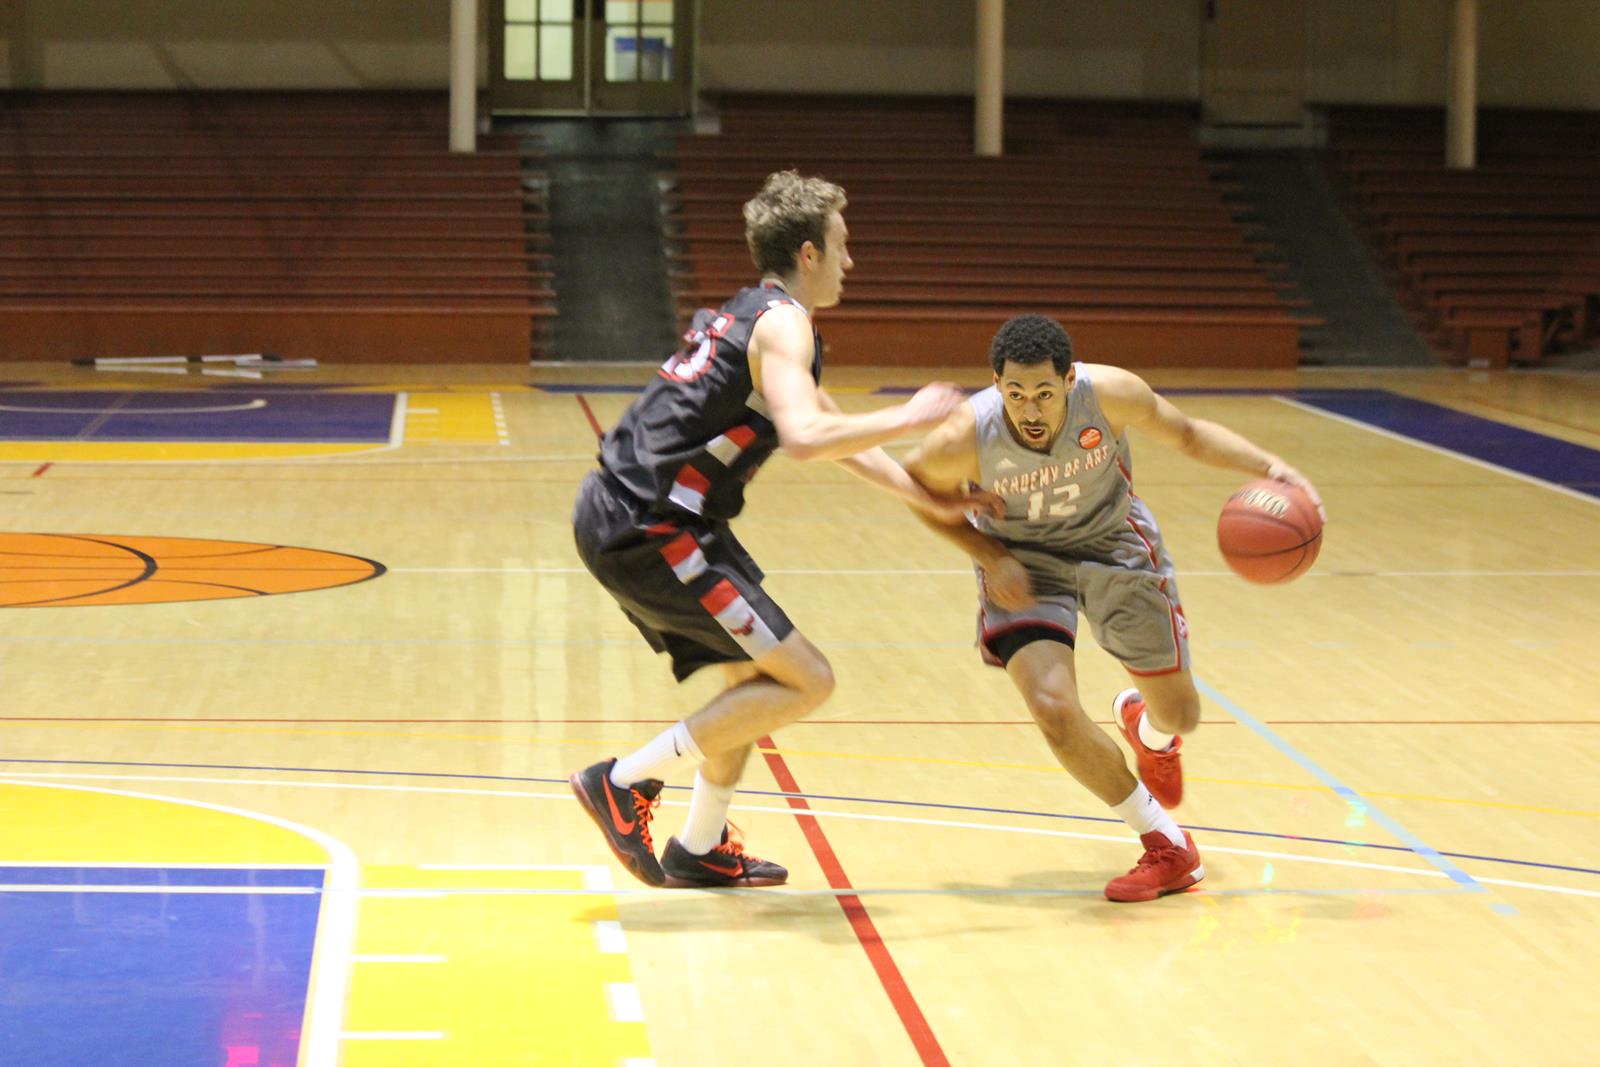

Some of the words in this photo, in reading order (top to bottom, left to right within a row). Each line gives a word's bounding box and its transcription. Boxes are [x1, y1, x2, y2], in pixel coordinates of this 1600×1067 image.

[992, 464, 1059, 496] ACADEMY
[1064, 458, 1080, 478] OF
[1085, 445, 1108, 471] ART
[1027, 483, 1081, 521] 12
